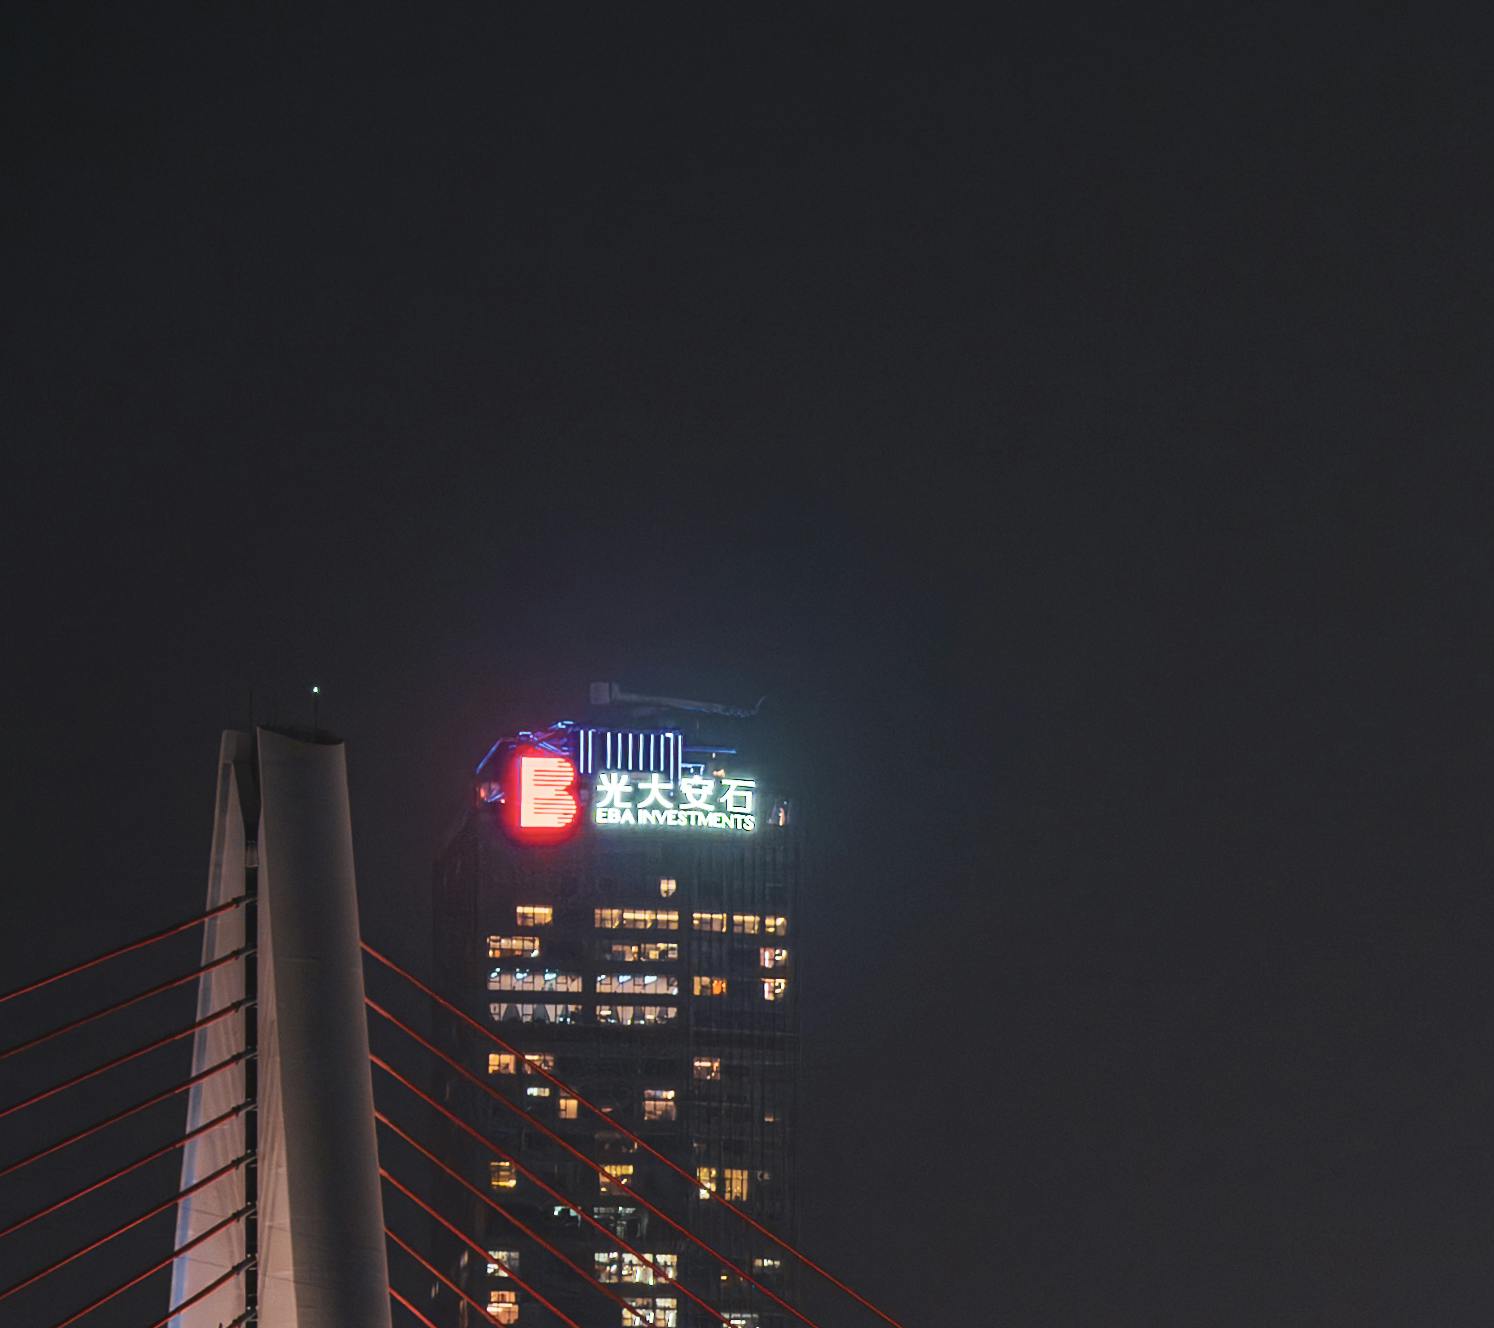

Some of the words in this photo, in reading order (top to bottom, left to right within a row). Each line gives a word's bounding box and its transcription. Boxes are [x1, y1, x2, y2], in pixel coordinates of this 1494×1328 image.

[596, 772, 756, 814] 光大安石
[596, 807, 634, 825] EBA
[638, 807, 756, 831] INVESTMENTS
